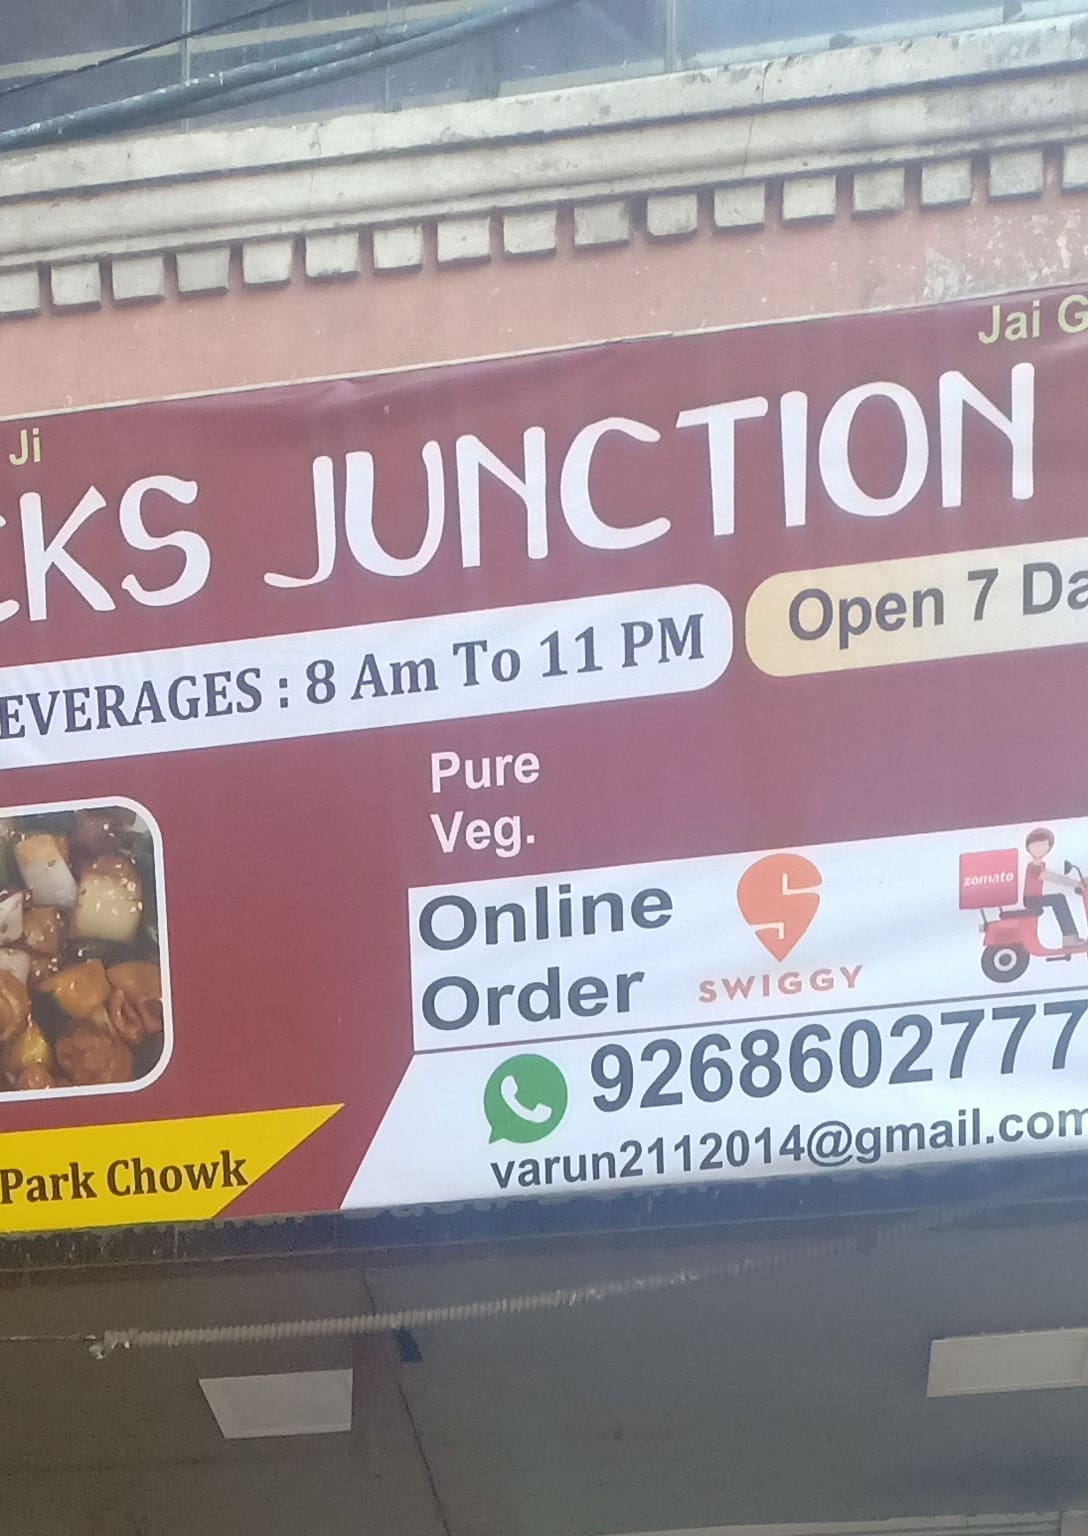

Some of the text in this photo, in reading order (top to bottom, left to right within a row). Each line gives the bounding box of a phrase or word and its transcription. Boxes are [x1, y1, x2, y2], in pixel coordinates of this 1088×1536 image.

[977, 300, 1041, 344] Jai
[8, 427, 43, 467] Ji
[263, 362, 1035, 588] JUNCTION
[788, 586, 945, 651] Open
[967, 567, 999, 622] 7
[305, 658, 337, 706] 8
[350, 653, 440, 702] Am
[452, 640, 522, 689] To
[540, 625, 605, 678] 11
[620, 612, 705, 670] PM
[429, 750, 541, 794] Pure
[429, 810, 536, 858] Veg.
[963, 871, 1015, 887] zomato
[418, 884, 674, 951] Online
[421, 966, 645, 1032] Order
[698, 963, 864, 1004] SWIGGY
[590, 999, 1088, 1113] 9268602777
[105, 1149, 249, 1196] Chowk
[490, 1107, 1088, 1190] varun2112014@gmail.com
